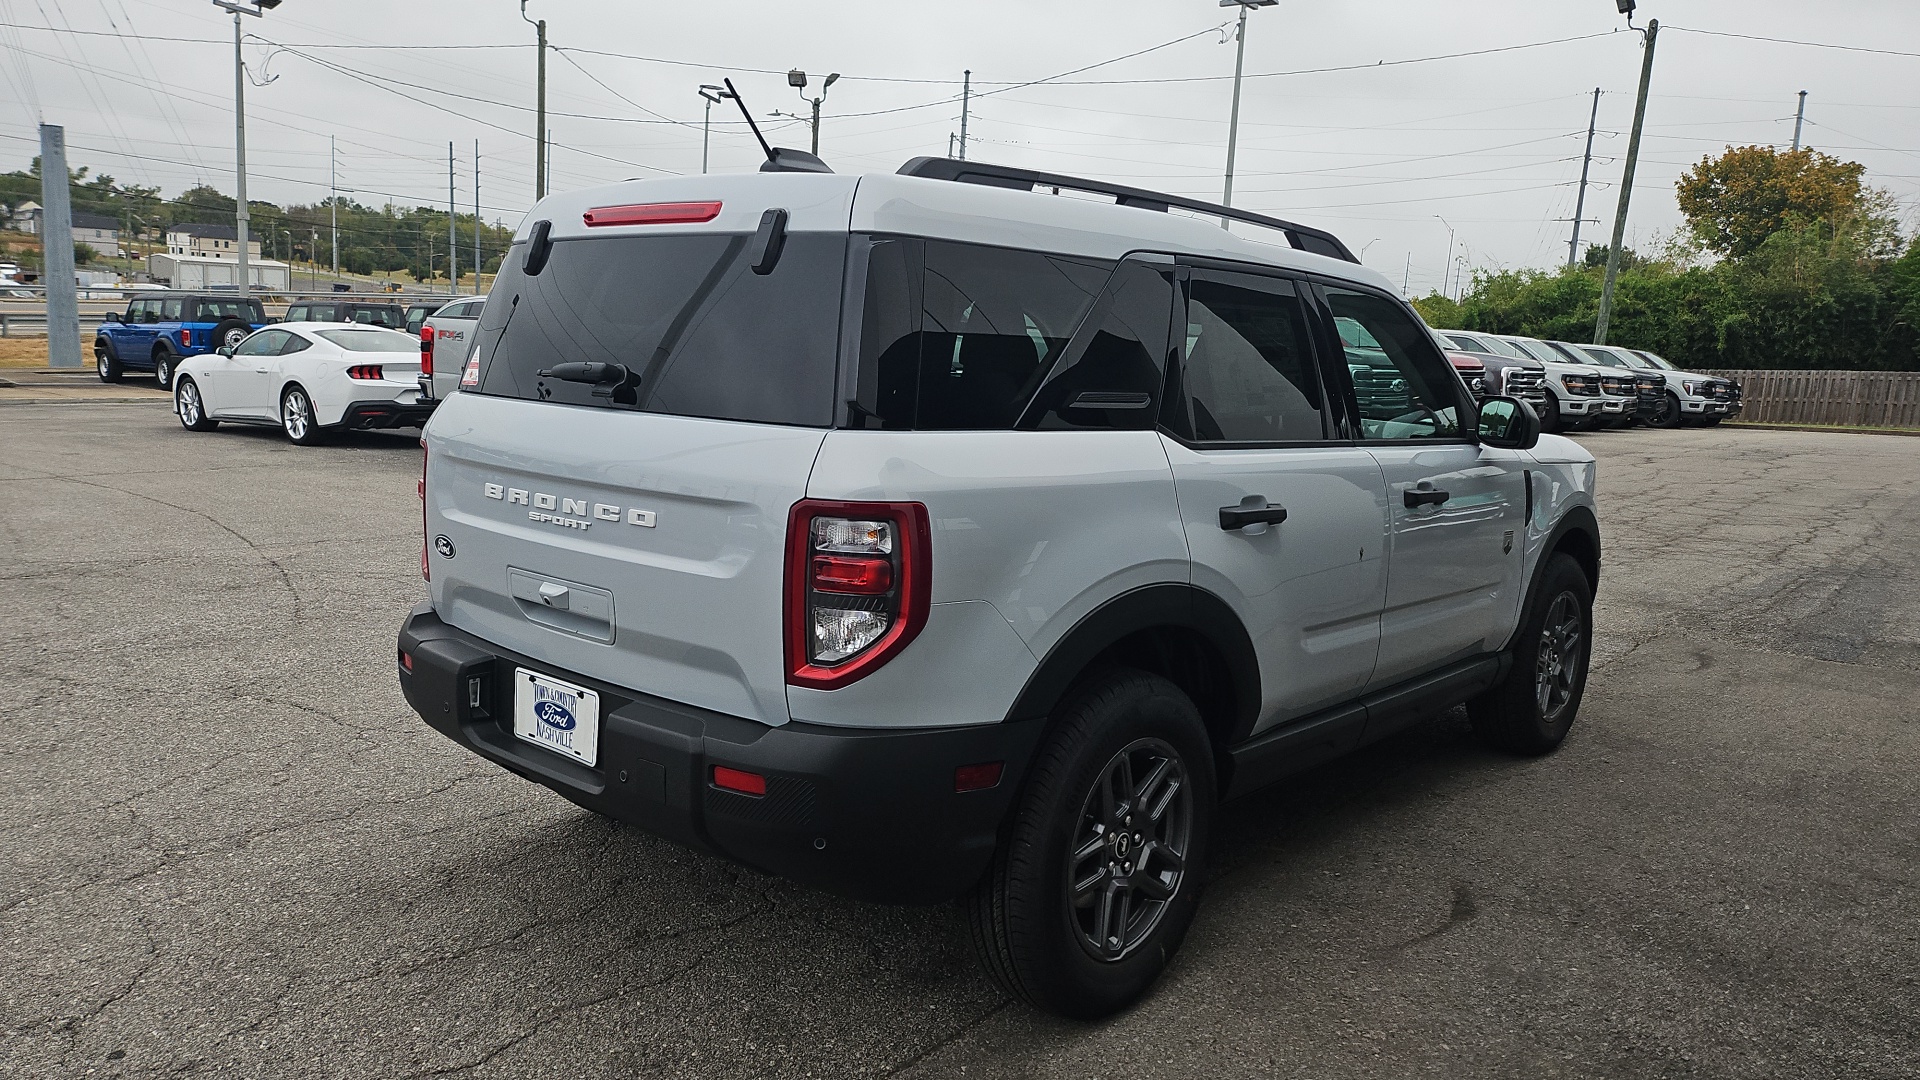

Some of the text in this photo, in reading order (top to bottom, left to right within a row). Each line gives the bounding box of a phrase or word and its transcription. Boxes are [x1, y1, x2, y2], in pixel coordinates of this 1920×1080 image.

[438, 329, 464, 341] FX4
[484, 482, 658, 528] BRONCO
[528, 511, 592, 531] SPORT
[532, 682, 550, 702] TOWN
[554, 689, 578, 719] COUNTRY
[541, 702, 569, 728] Ford
[536, 718, 574, 750] NASHVILLE
